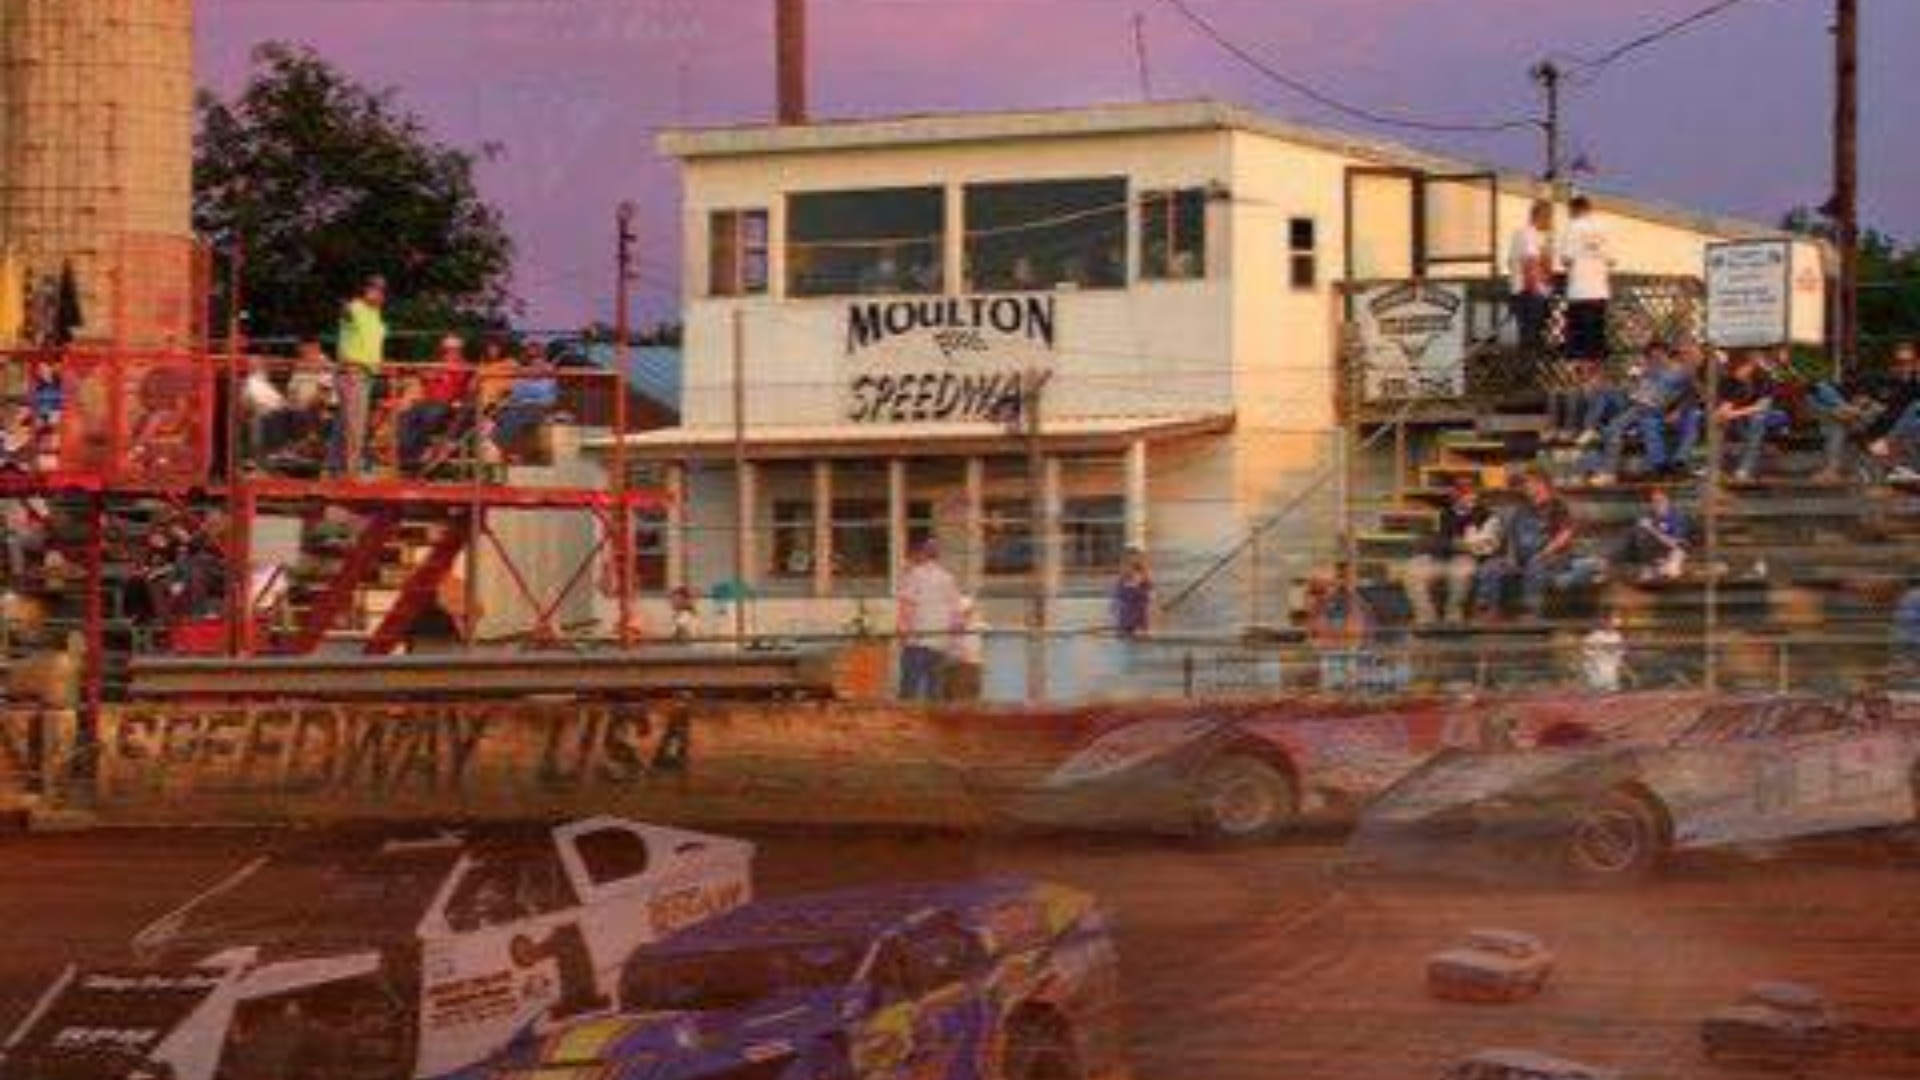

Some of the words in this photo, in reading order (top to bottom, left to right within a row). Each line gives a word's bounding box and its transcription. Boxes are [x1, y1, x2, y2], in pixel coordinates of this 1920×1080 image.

[848, 298, 1055, 352] MOULTON
[849, 369, 1053, 423] SPEEDWAY
[538, 703, 690, 784] USA
